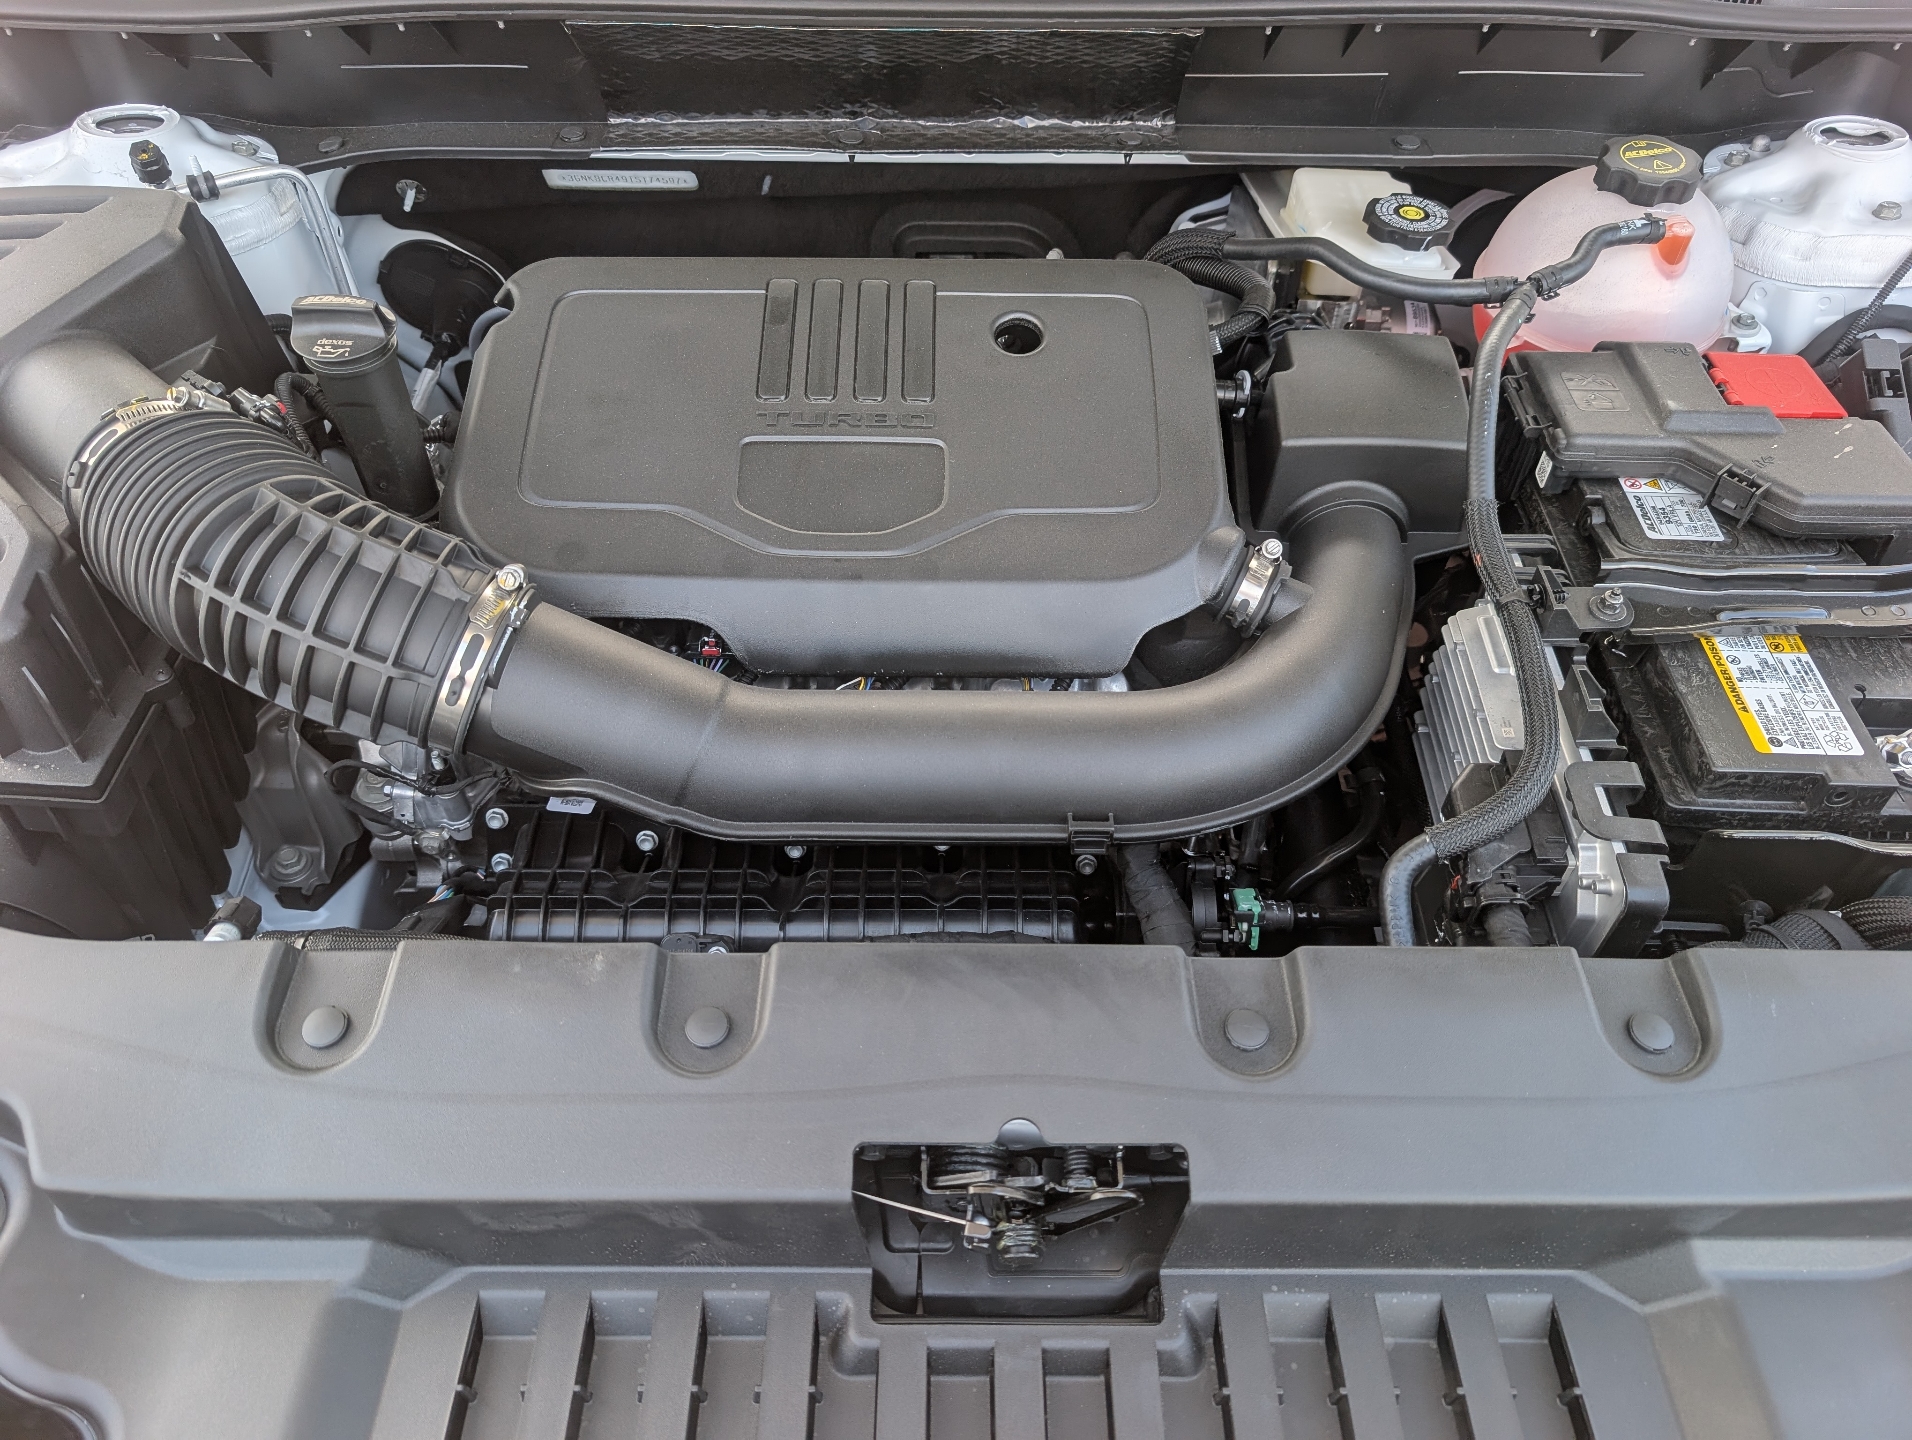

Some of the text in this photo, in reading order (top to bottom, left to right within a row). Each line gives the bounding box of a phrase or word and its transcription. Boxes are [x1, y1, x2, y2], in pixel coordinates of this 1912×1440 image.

[1624, 147, 1672, 158] ACDelco
[301, 295, 367, 305] ACDelco
[316, 337, 354, 347] dexos
[755, 410, 935, 428] TURBO
[1632, 494, 1658, 533] ACDelco
